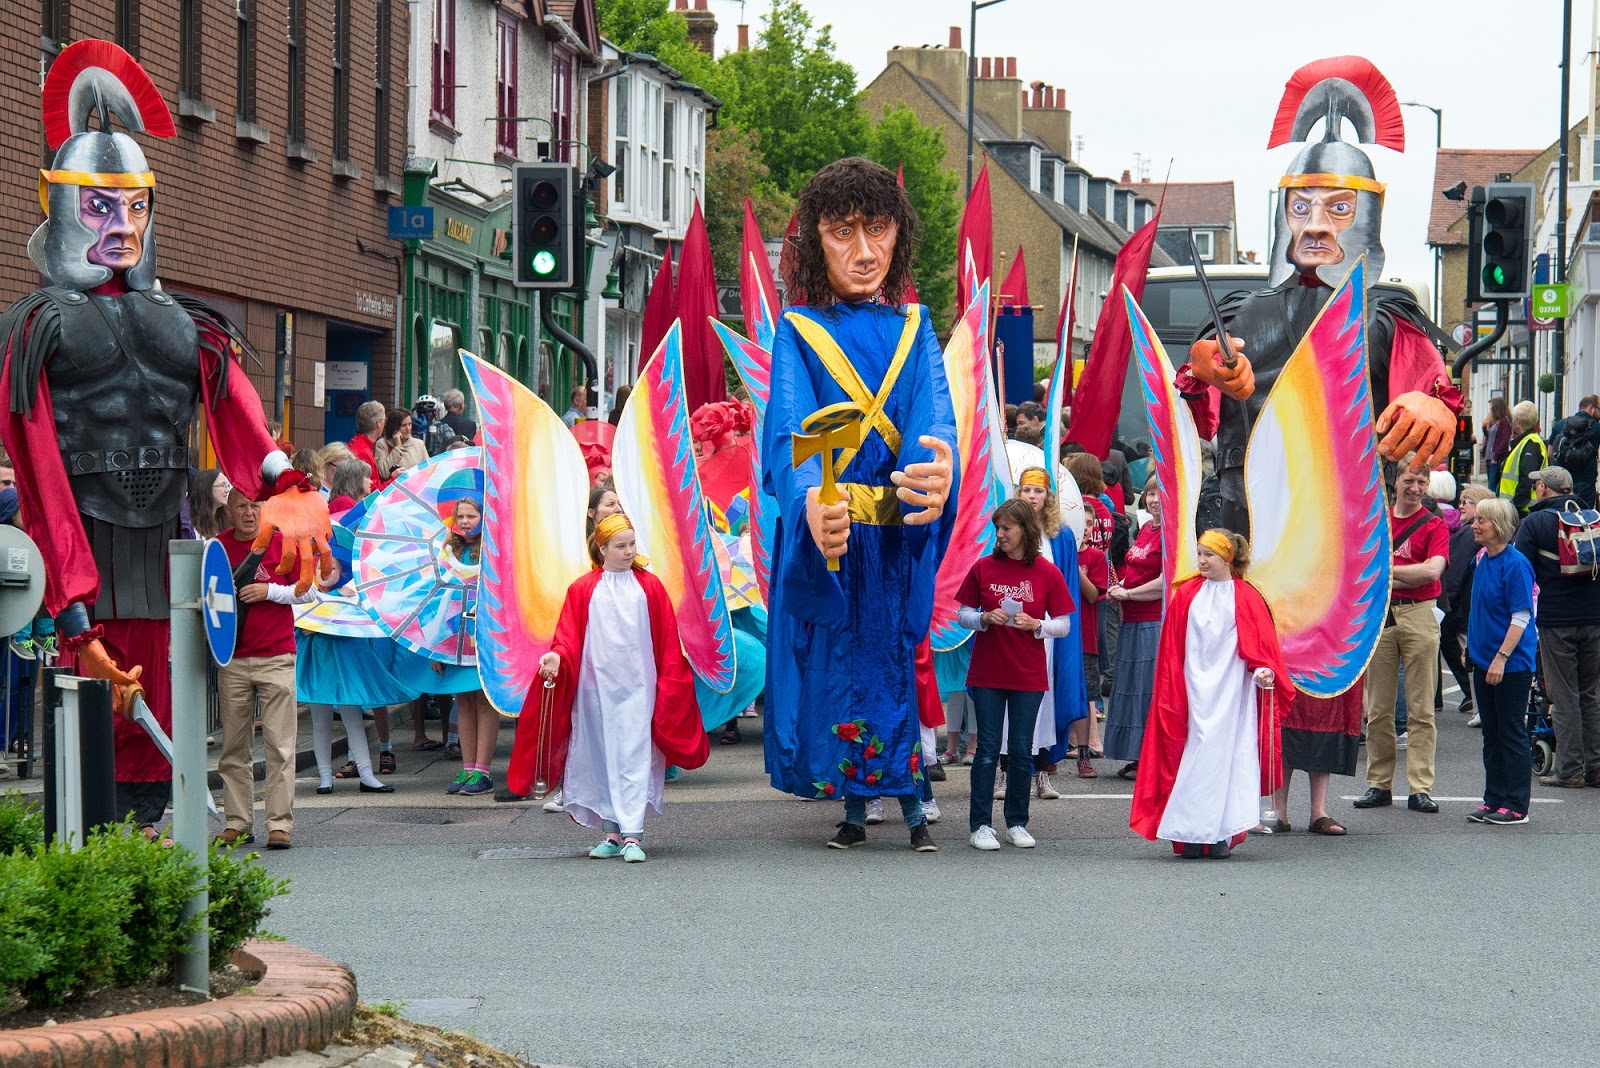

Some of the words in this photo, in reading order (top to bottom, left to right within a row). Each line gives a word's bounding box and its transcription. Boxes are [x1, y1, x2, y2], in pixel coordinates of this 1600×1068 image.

[401, 210, 425, 229] 1a
[447, 217, 475, 245] TAKEAWAY
[1539, 305, 1561, 313] OXFAM
